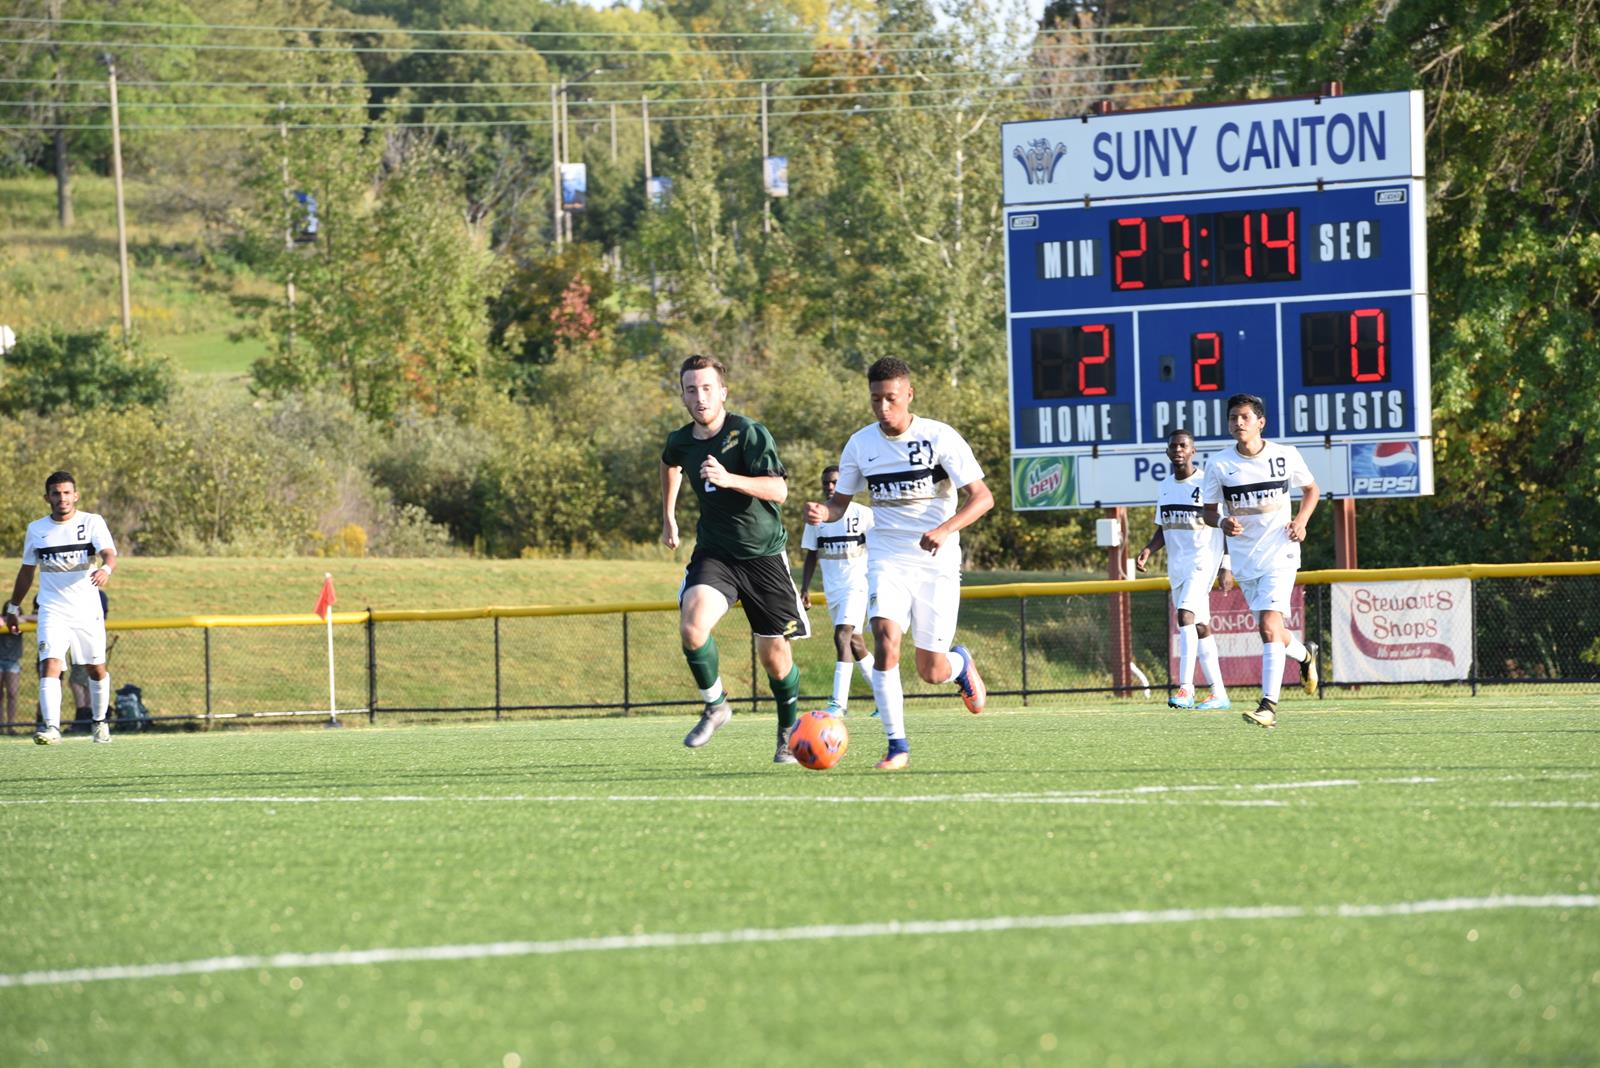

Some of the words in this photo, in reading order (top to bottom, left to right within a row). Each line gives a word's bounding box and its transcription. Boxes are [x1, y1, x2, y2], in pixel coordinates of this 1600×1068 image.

[1093, 126, 1197, 181] SUNY
[1216, 110, 1386, 172] CANTON
[1043, 239, 1094, 279] MIN
[1115, 210, 1296, 289] 27:14
[1319, 220, 1371, 261] SEC
[1078, 324, 1109, 395] 2
[1194, 333, 1220, 390] 2
[1350, 308, 1385, 382] 0
[1039, 404, 1112, 443] HOME
[1156, 398, 1222, 438] PERI
[1294, 390, 1403, 432] GUESTS
[907, 440, 933, 466] 27
[1268, 457, 1286, 478] 19
[1191, 487, 1200, 503] 4
[1354, 476, 1418, 493] PEPSI
[77, 525, 86, 540] 2
[847, 518, 859, 533] 12
